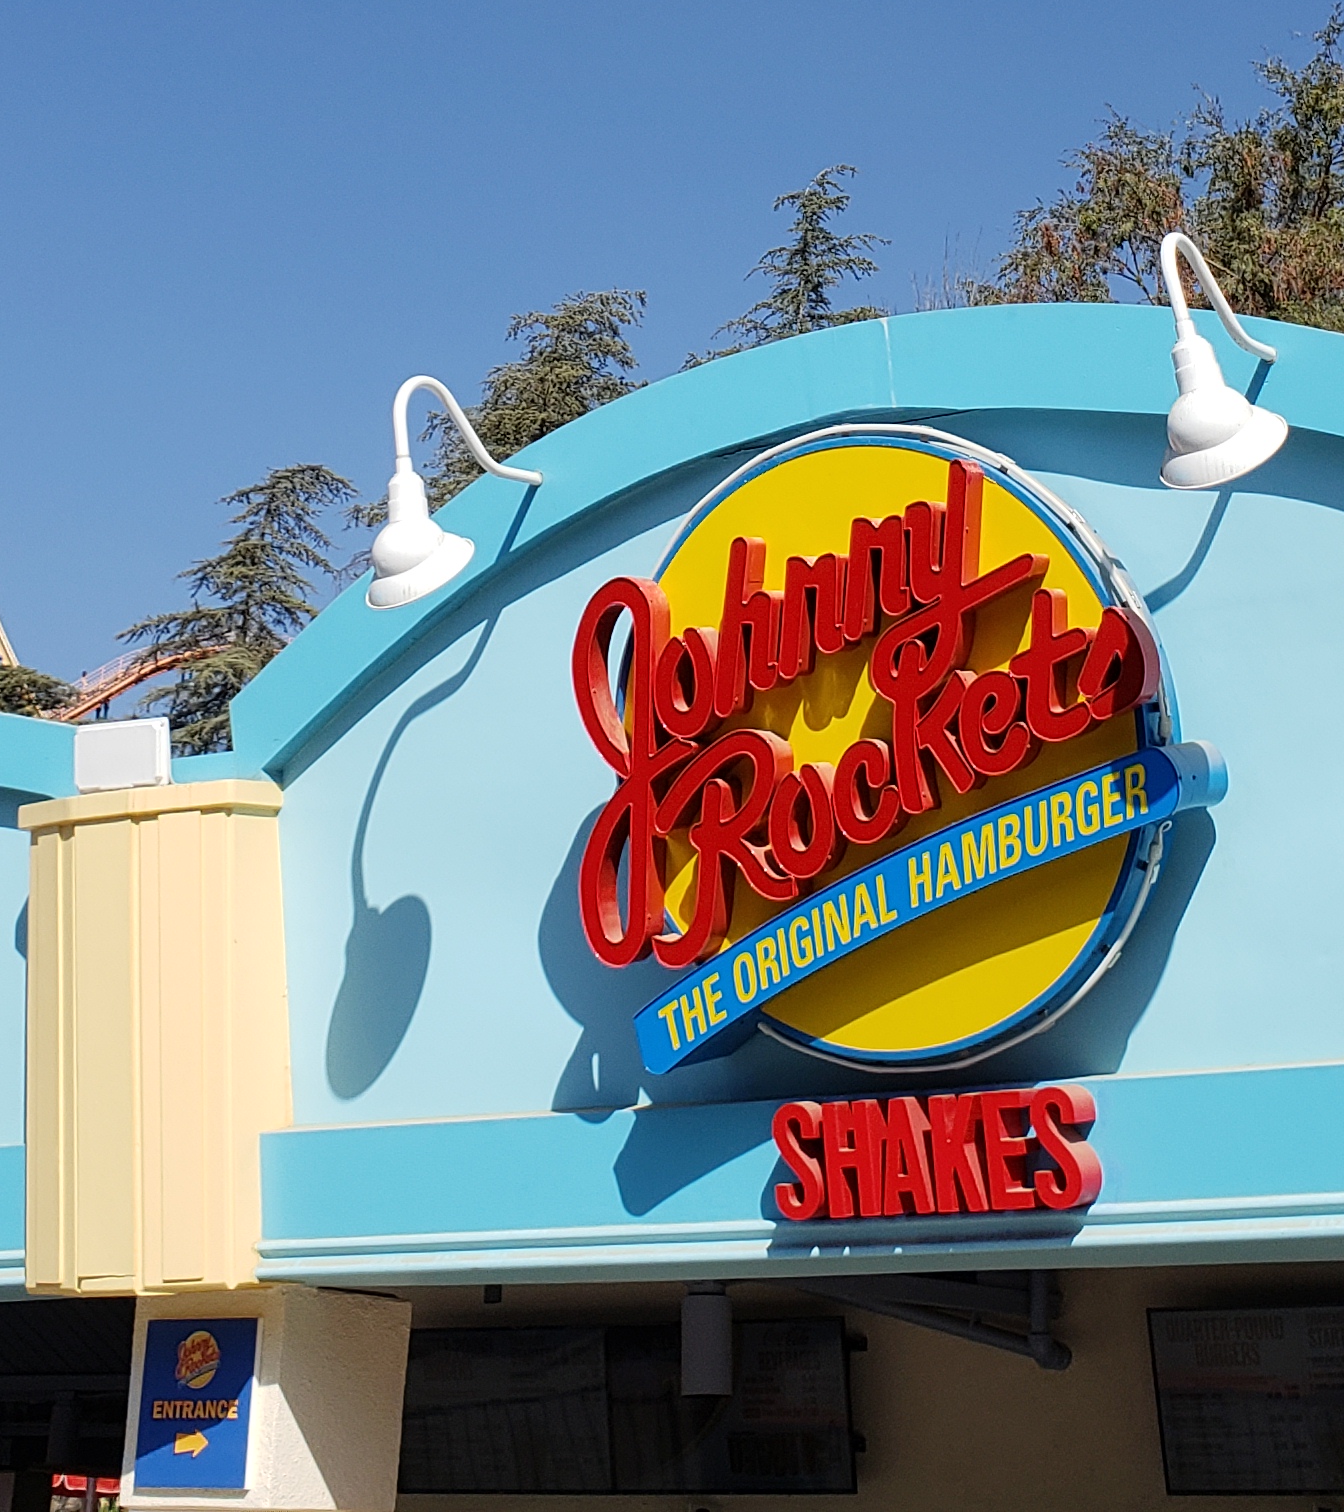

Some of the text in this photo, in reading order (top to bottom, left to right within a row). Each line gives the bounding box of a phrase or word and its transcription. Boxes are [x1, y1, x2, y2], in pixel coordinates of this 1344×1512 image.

[573, 459, 1048, 969] Johnny
[655, 587, 1160, 969] Rockets
[658, 762, 1150, 1051] THE ORIGINAL HAMBURGER
[773, 1085, 1104, 1220] SHAKES
[152, 1399, 239, 1419] ENTRANCE
